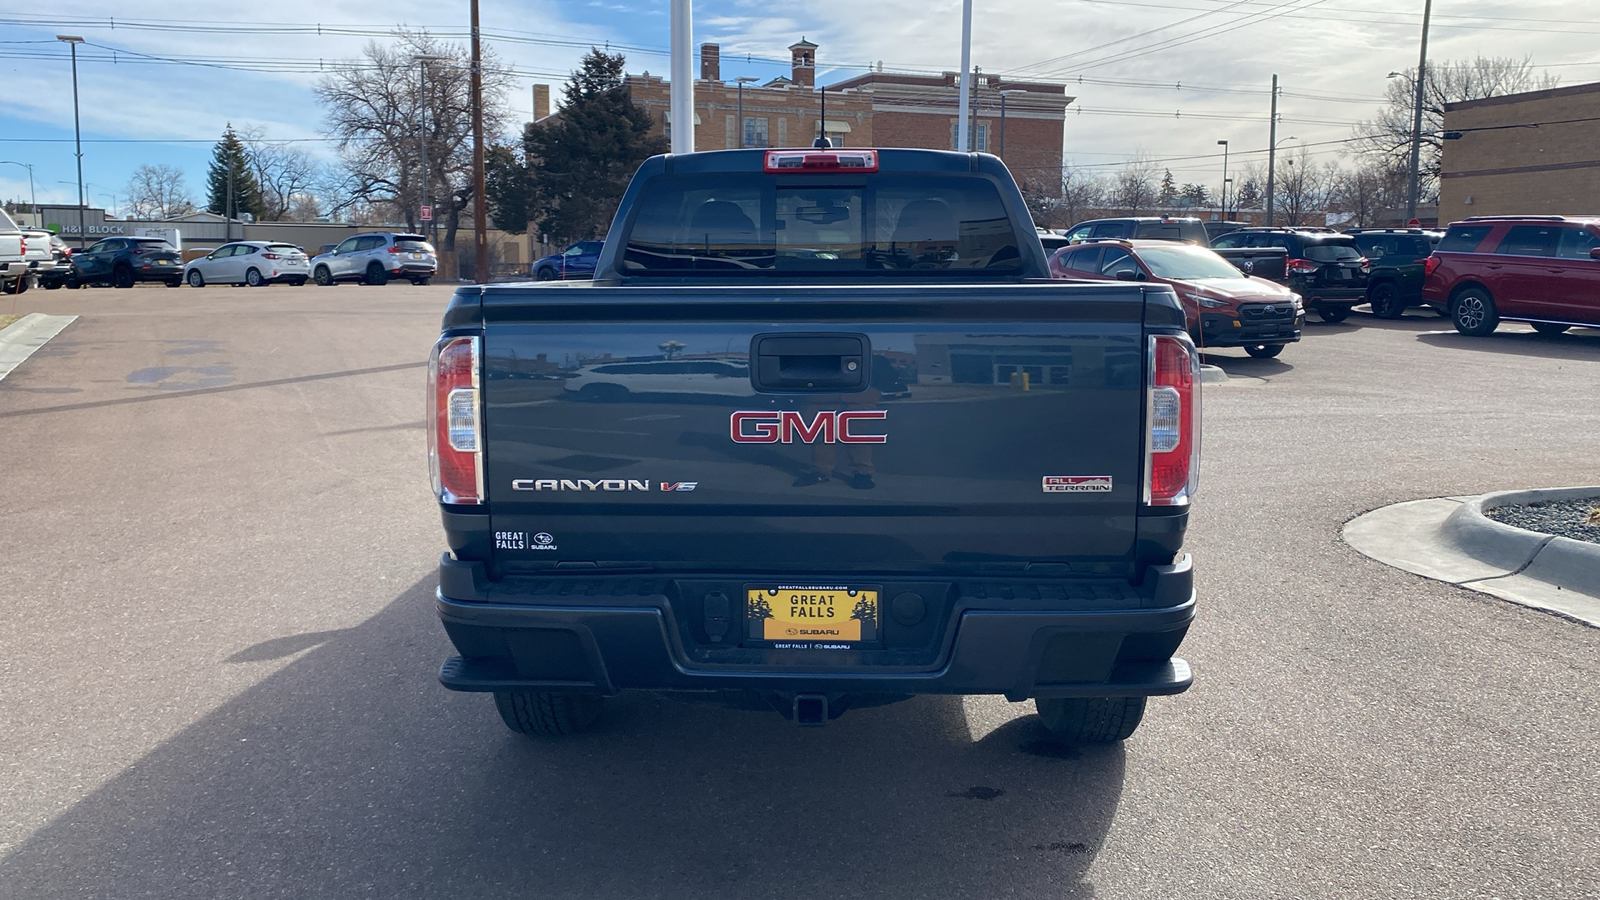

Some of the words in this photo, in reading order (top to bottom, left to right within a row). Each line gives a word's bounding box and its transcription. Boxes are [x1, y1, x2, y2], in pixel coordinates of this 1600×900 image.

[88, 225, 124, 234] BLOCK
[730, 410, 888, 444] GMC
[511, 479, 650, 492] CANYON
[660, 481, 698, 492] V6
[495, 532, 523, 540] GREAT
[496, 541, 524, 549] FALLS
[790, 595, 835, 606] GREAT
[790, 606, 835, 618] FALLS
